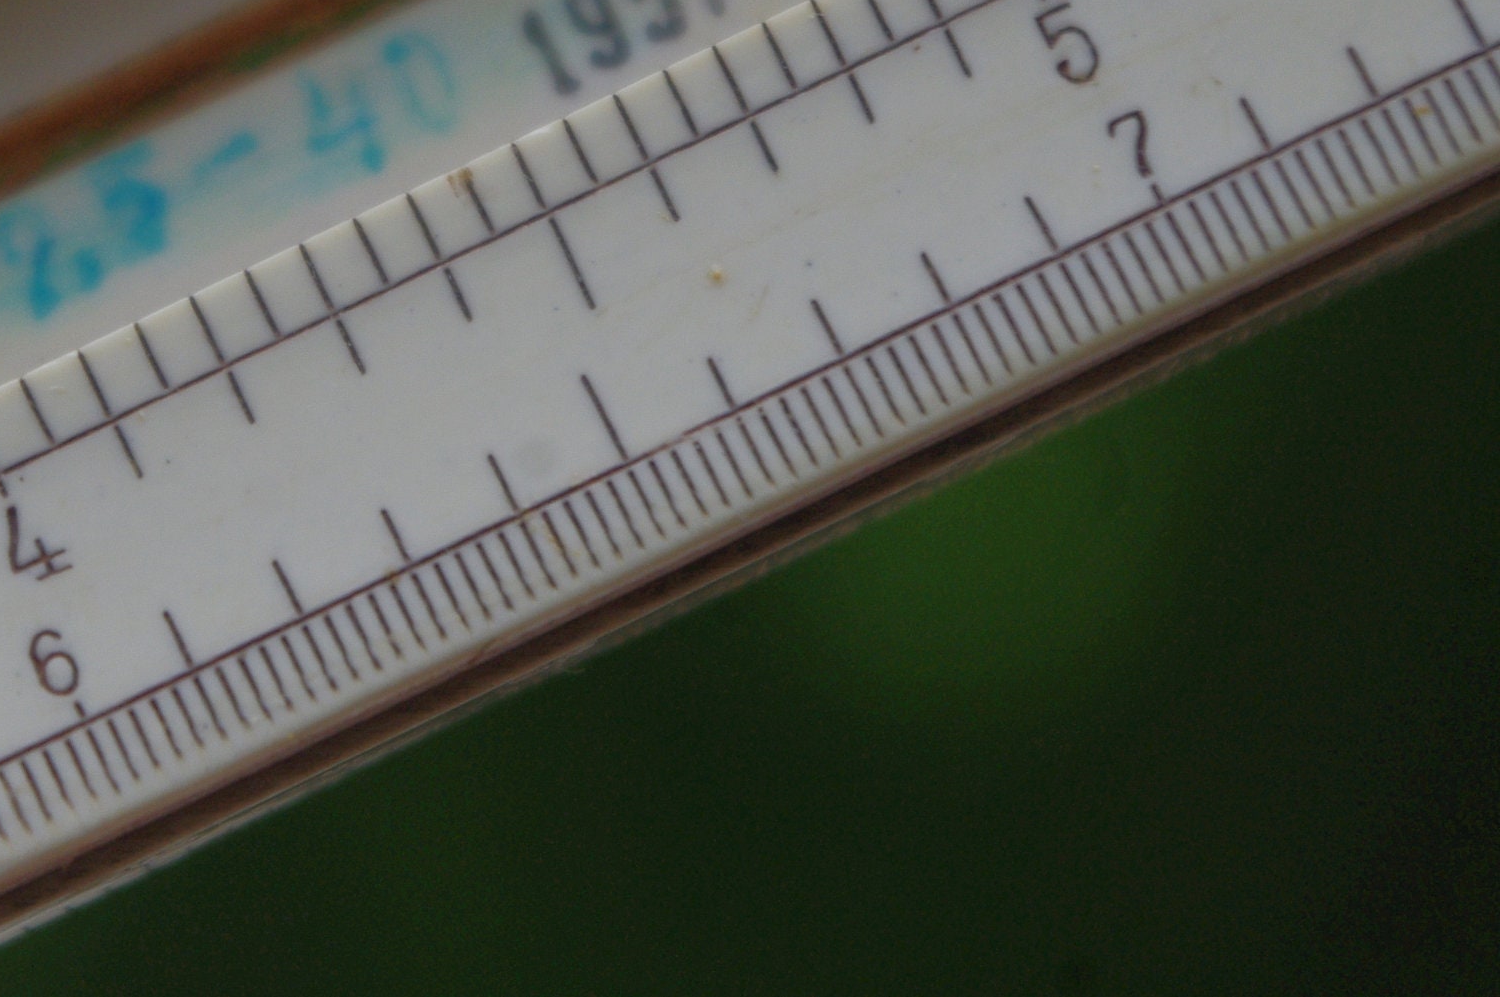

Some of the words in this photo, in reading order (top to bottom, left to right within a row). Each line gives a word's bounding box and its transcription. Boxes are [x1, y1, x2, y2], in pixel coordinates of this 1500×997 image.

[5, 505, 73, 581] 4
[1034, 2, 1099, 84] 5
[28, 629, 79, 696] 6
[1107, 109, 1153, 177] 7
